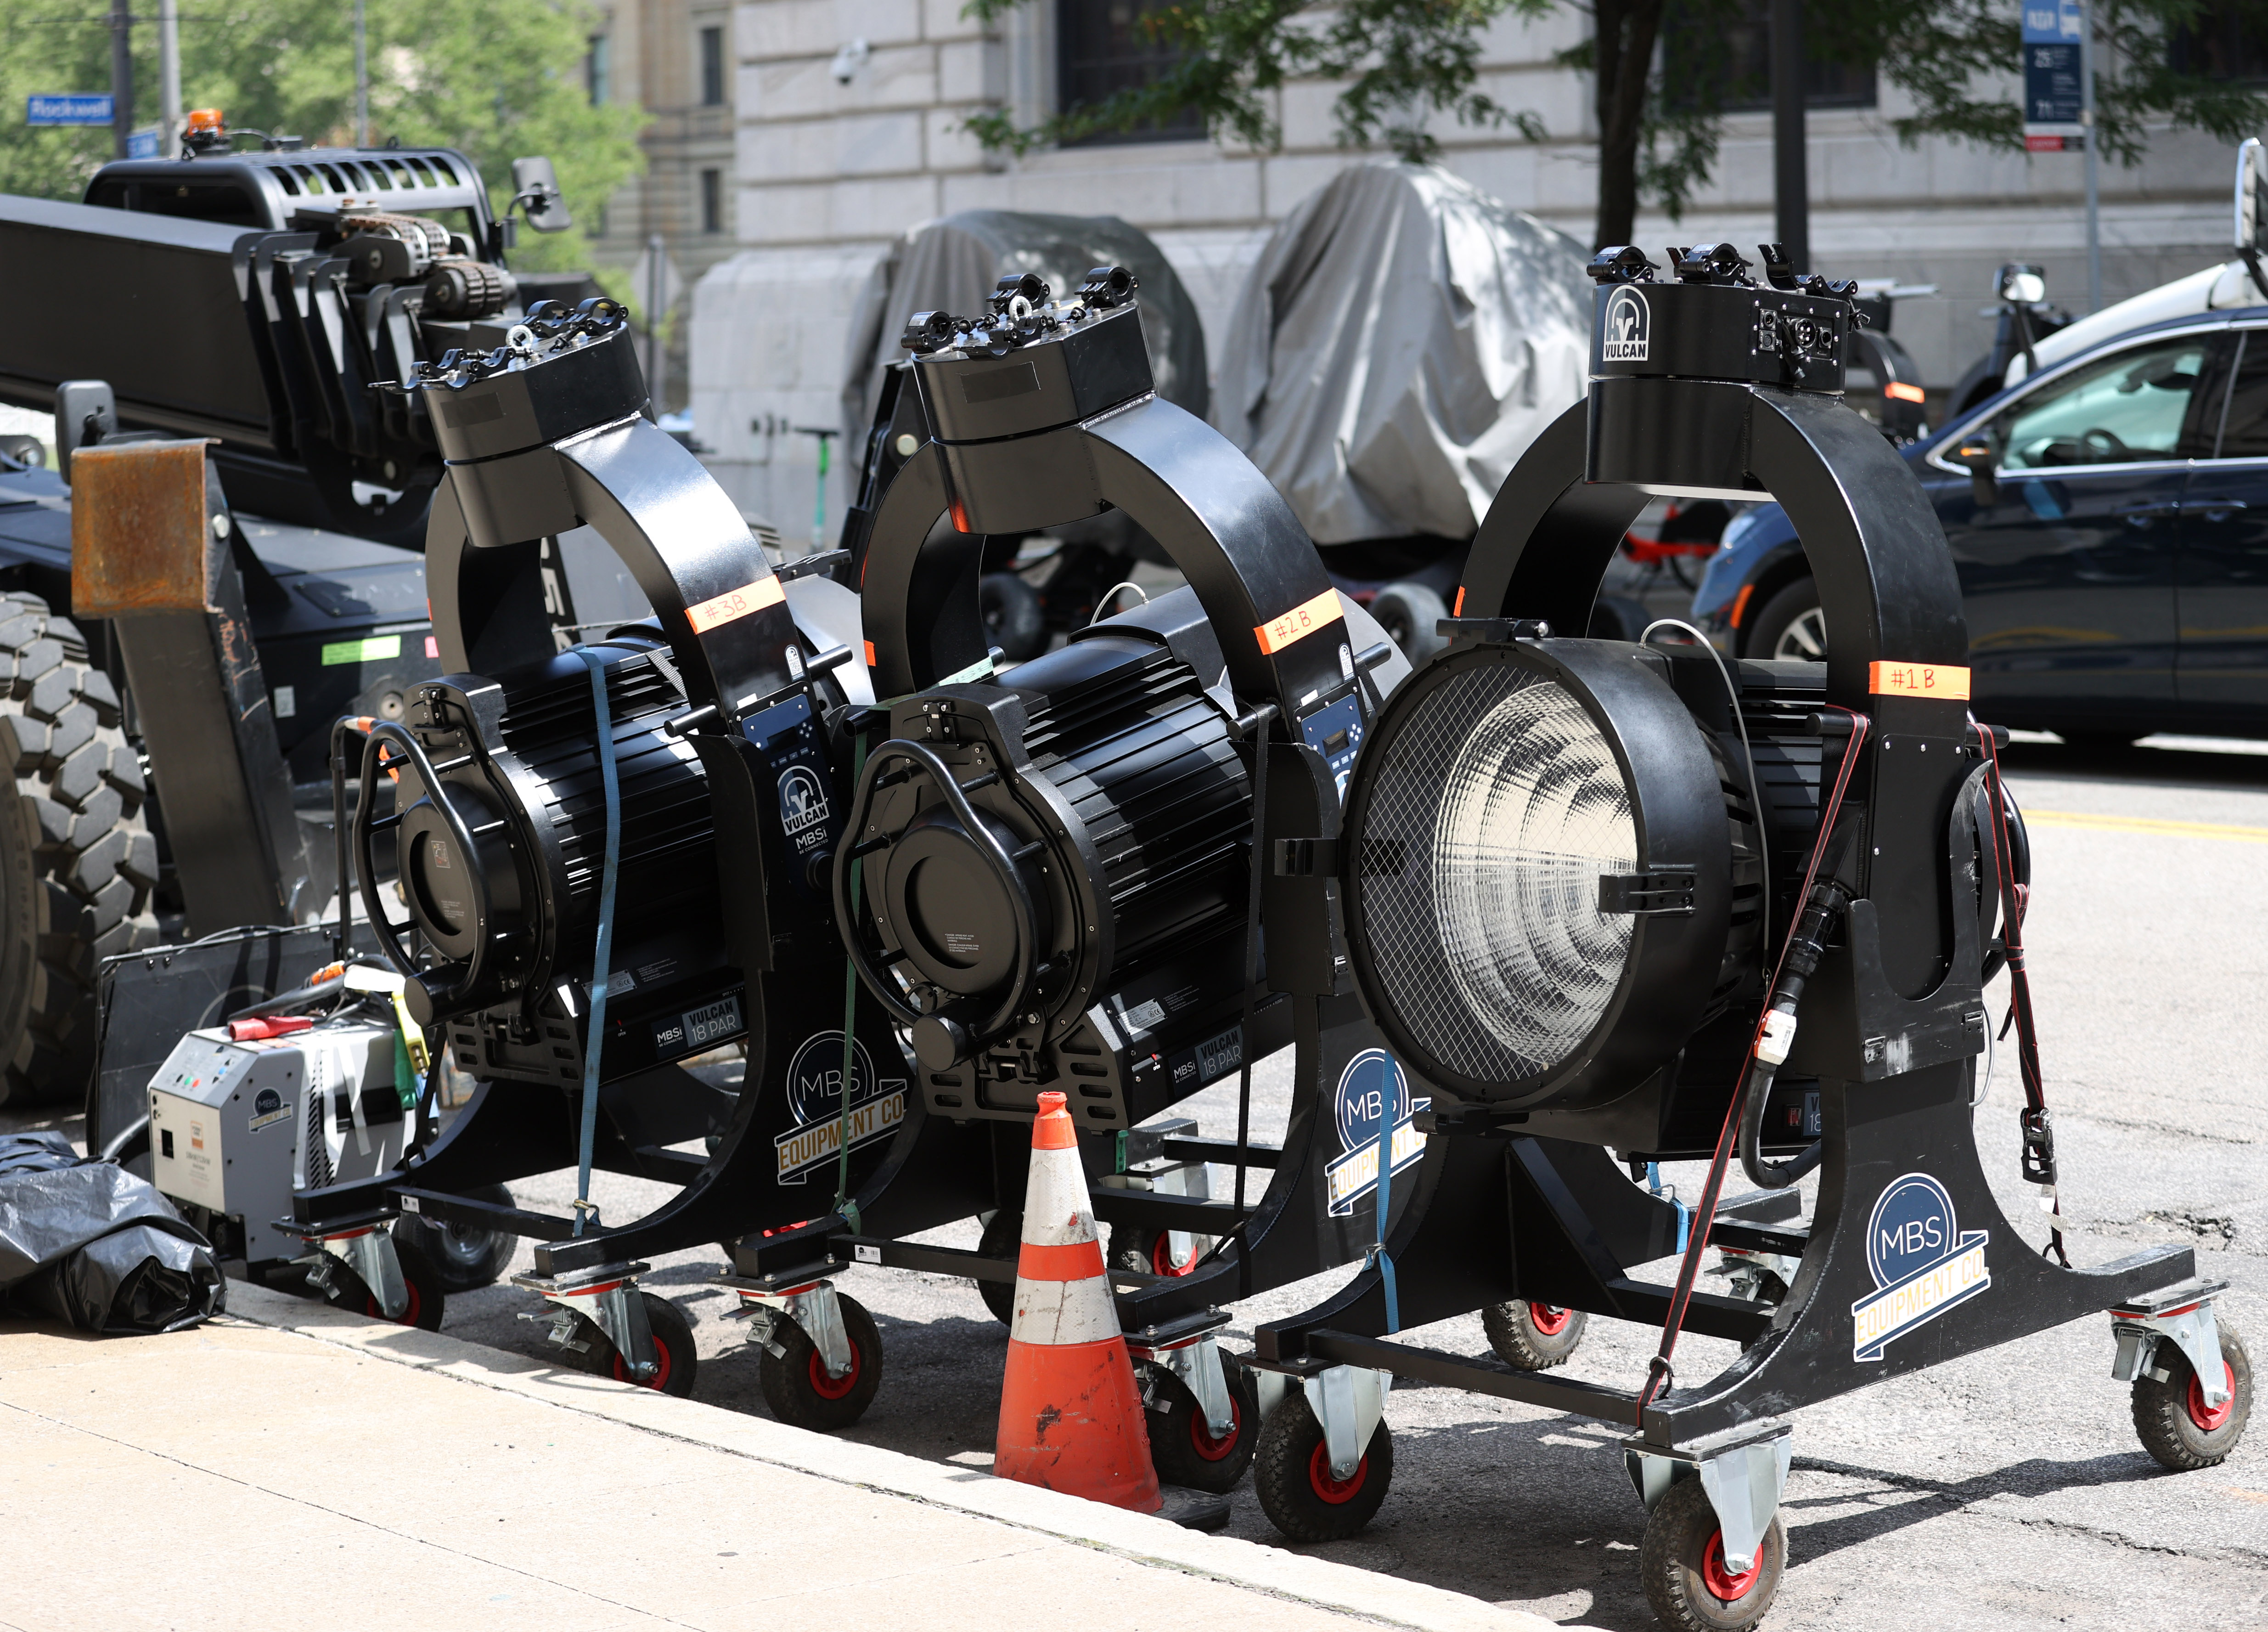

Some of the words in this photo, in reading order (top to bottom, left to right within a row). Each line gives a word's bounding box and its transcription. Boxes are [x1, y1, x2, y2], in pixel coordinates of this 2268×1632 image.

[31, 98, 111, 118] Rockwell
[1605, 344, 1646, 358] VULCAN
[704, 595, 747, 620] #3B
[785, 805, 827, 832] VULCAN
[805, 839, 828, 852] CONNECTED
[688, 1001, 734, 1026] VULCAN
[664, 1036, 683, 1046] CONNECTED
[692, 1025, 706, 1042] 18
[709, 1015, 736, 1036] PAR
[1200, 1030, 1239, 1059] VULCAN
[1203, 1057, 1216, 1076] 18
[1218, 1045, 1242, 1069] PAR
[801, 1067, 860, 1101] MBS
[1180, 1071, 1196, 1082] CONNECTED
[258, 1098, 277, 1109] MBS
[1347, 1090, 1396, 1126] MB
[1330, 1128, 1408, 1200] EQUIPMNT
[1881, 1216, 1942, 1260] MBS
[1857, 1264, 1955, 1343] EQUIPMENT
[1962, 1250, 1987, 1286] CO.
